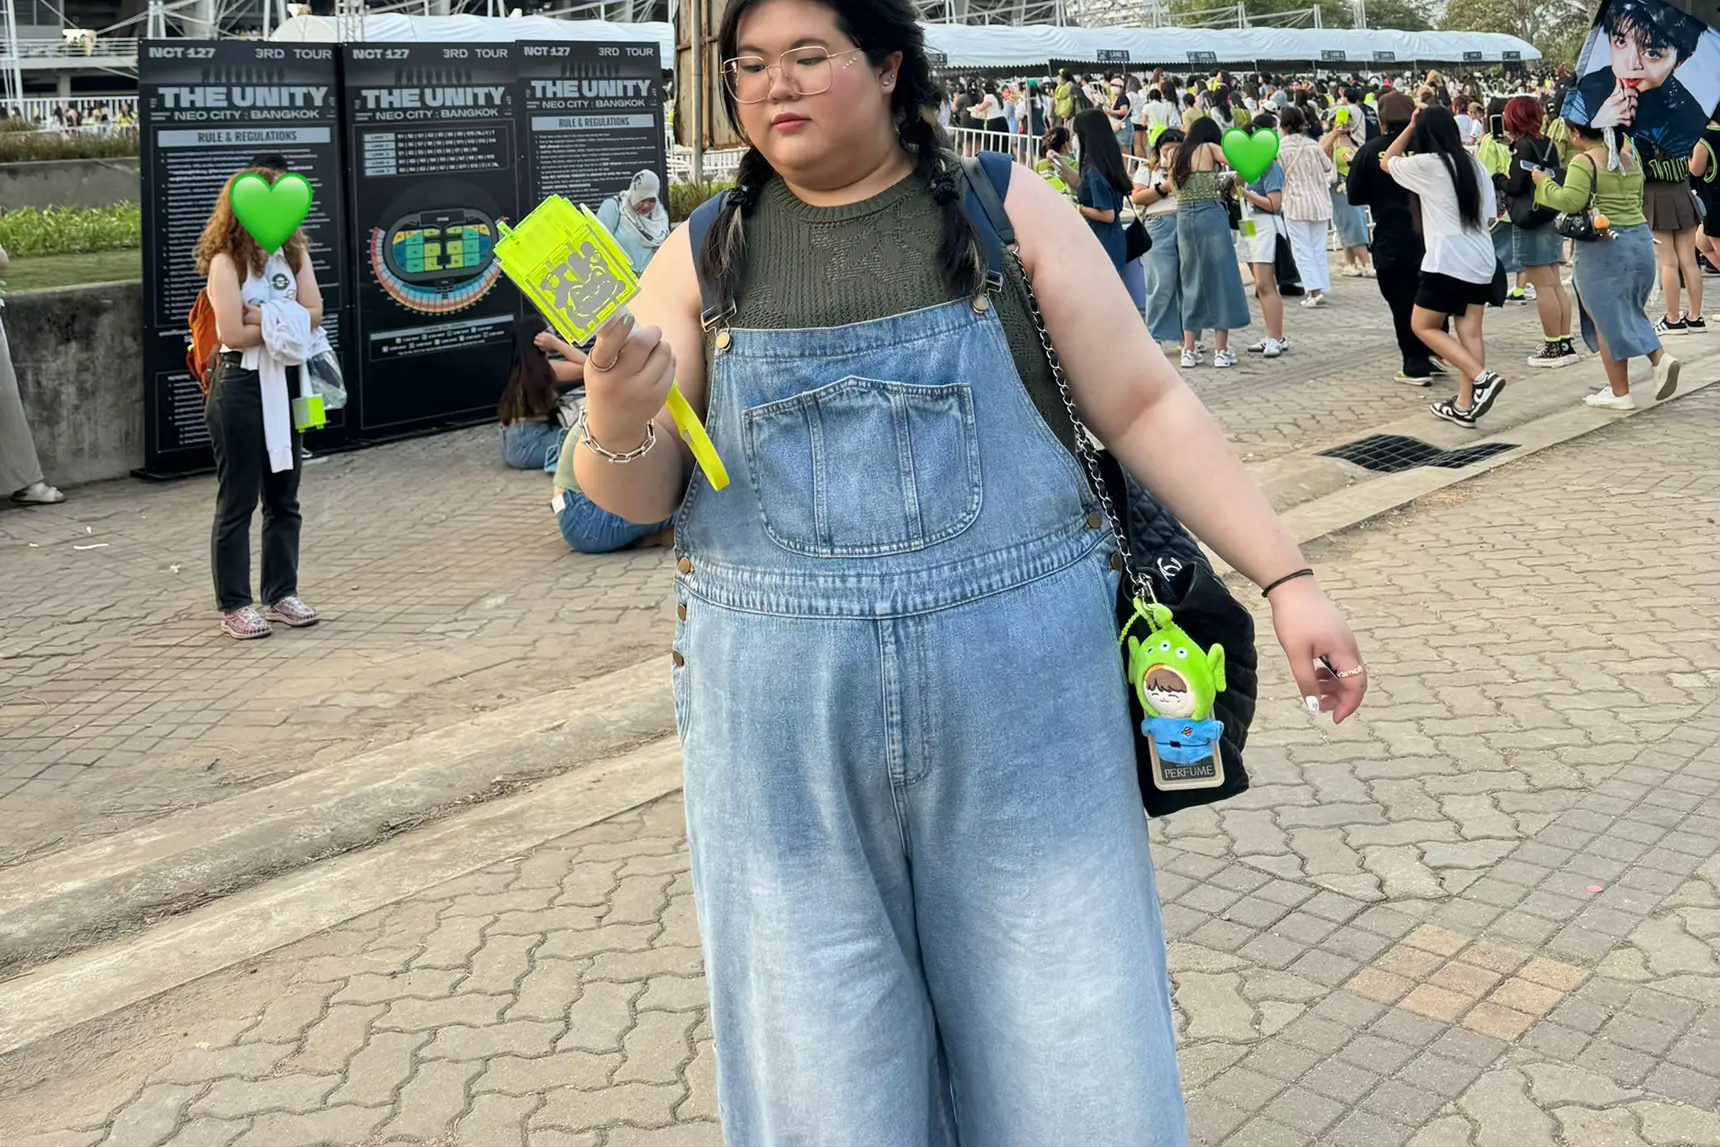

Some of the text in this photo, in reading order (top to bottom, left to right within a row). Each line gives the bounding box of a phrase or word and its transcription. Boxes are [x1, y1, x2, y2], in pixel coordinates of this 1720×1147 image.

[149, 47, 332, 60] NCT 127 3RD TOUR
[352, 48, 508, 60] NCT 127 3RD TOUR
[524, 46, 654, 57] NCT 127 3RD TOUR
[531, 79, 651, 99] THE UNITY
[158, 86, 229, 108] THE
[232, 86, 328, 108] UNITY
[361, 86, 505, 109] THE UNITY
[542, 101, 565, 109] NEO
[567, 100, 588, 109] CITY
[596, 99, 646, 108] BANGKOK
[174, 111, 207, 121] NEO
[209, 110, 242, 120] CITY
[251, 109, 320, 120] BANGKOK
[375, 111, 403, 121] NEO
[406, 110, 433, 120] CITY
[441, 108, 499, 119] BANGKOK
[559, 116, 631, 128] RULE & REGULATIONS
[198, 130, 298, 144] RULE & REGULATIONS
[1164, 765, 1214, 778] PERFUME
